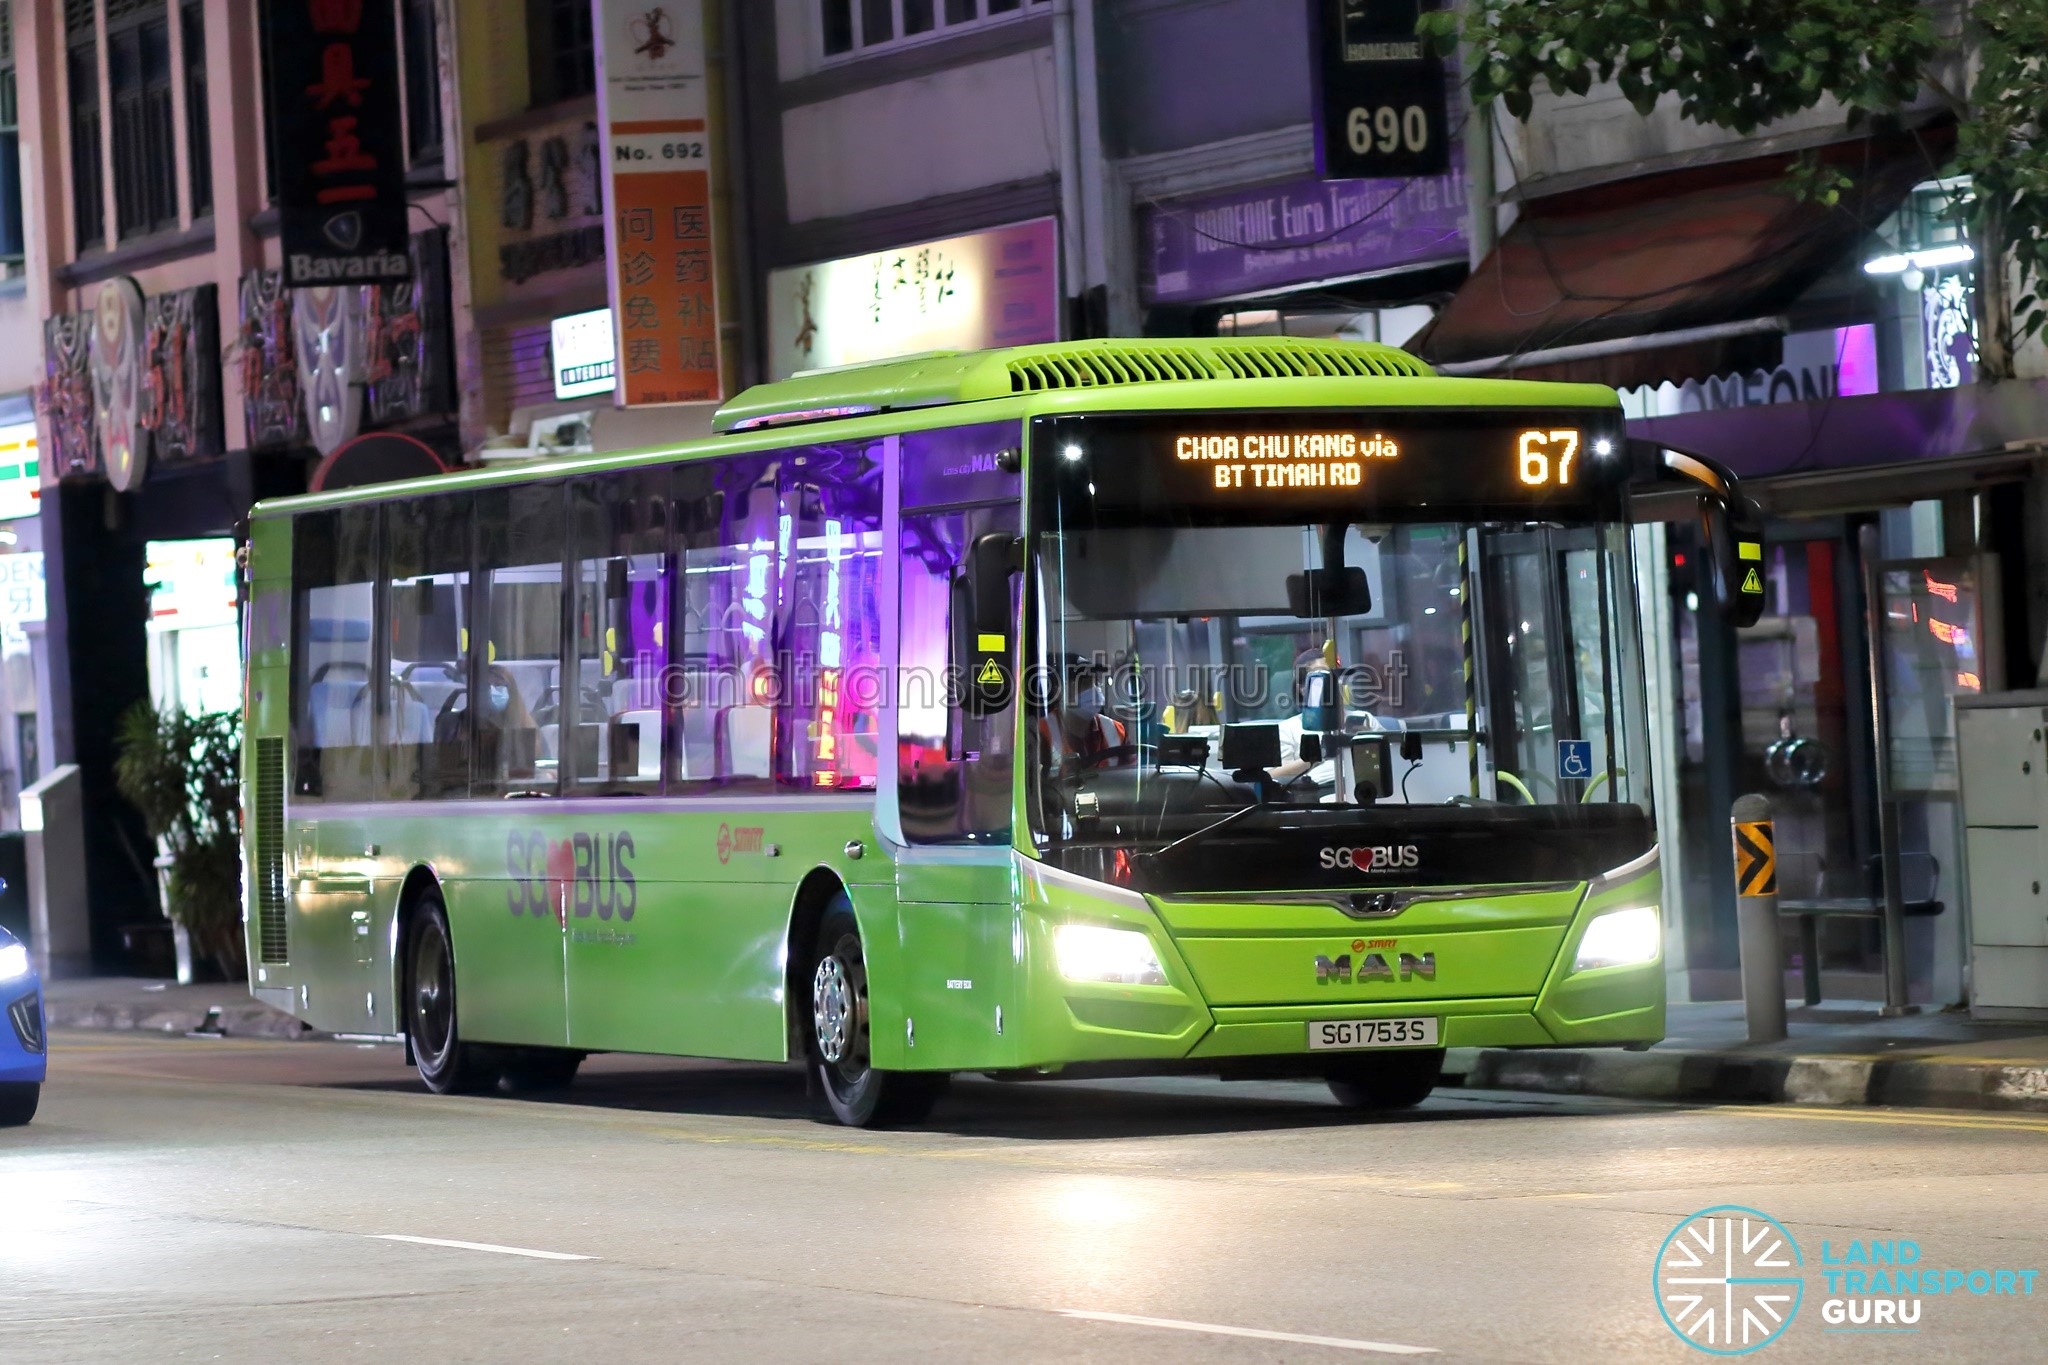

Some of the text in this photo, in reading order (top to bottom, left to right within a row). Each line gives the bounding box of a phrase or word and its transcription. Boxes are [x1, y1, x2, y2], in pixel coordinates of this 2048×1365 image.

[1347, 106, 1427, 154] 690
[616, 143, 703, 160] No. 692
[1281, 196, 1324, 238] Euro
[291, 251, 408, 281] Bavaria
[620, 208, 662, 373] 问诊免费
[673, 205, 715, 372] 医药补贴
[1176, 433, 1398, 460] CHOA CHU KANG via
[1518, 431, 1579, 485] 67
[1214, 462, 1361, 488] BT TIMAH RD
[1368, 939, 1398, 949] SMRT
[1315, 952, 1436, 985] MAN
[1322, 1021, 1425, 1044] SG1753S
